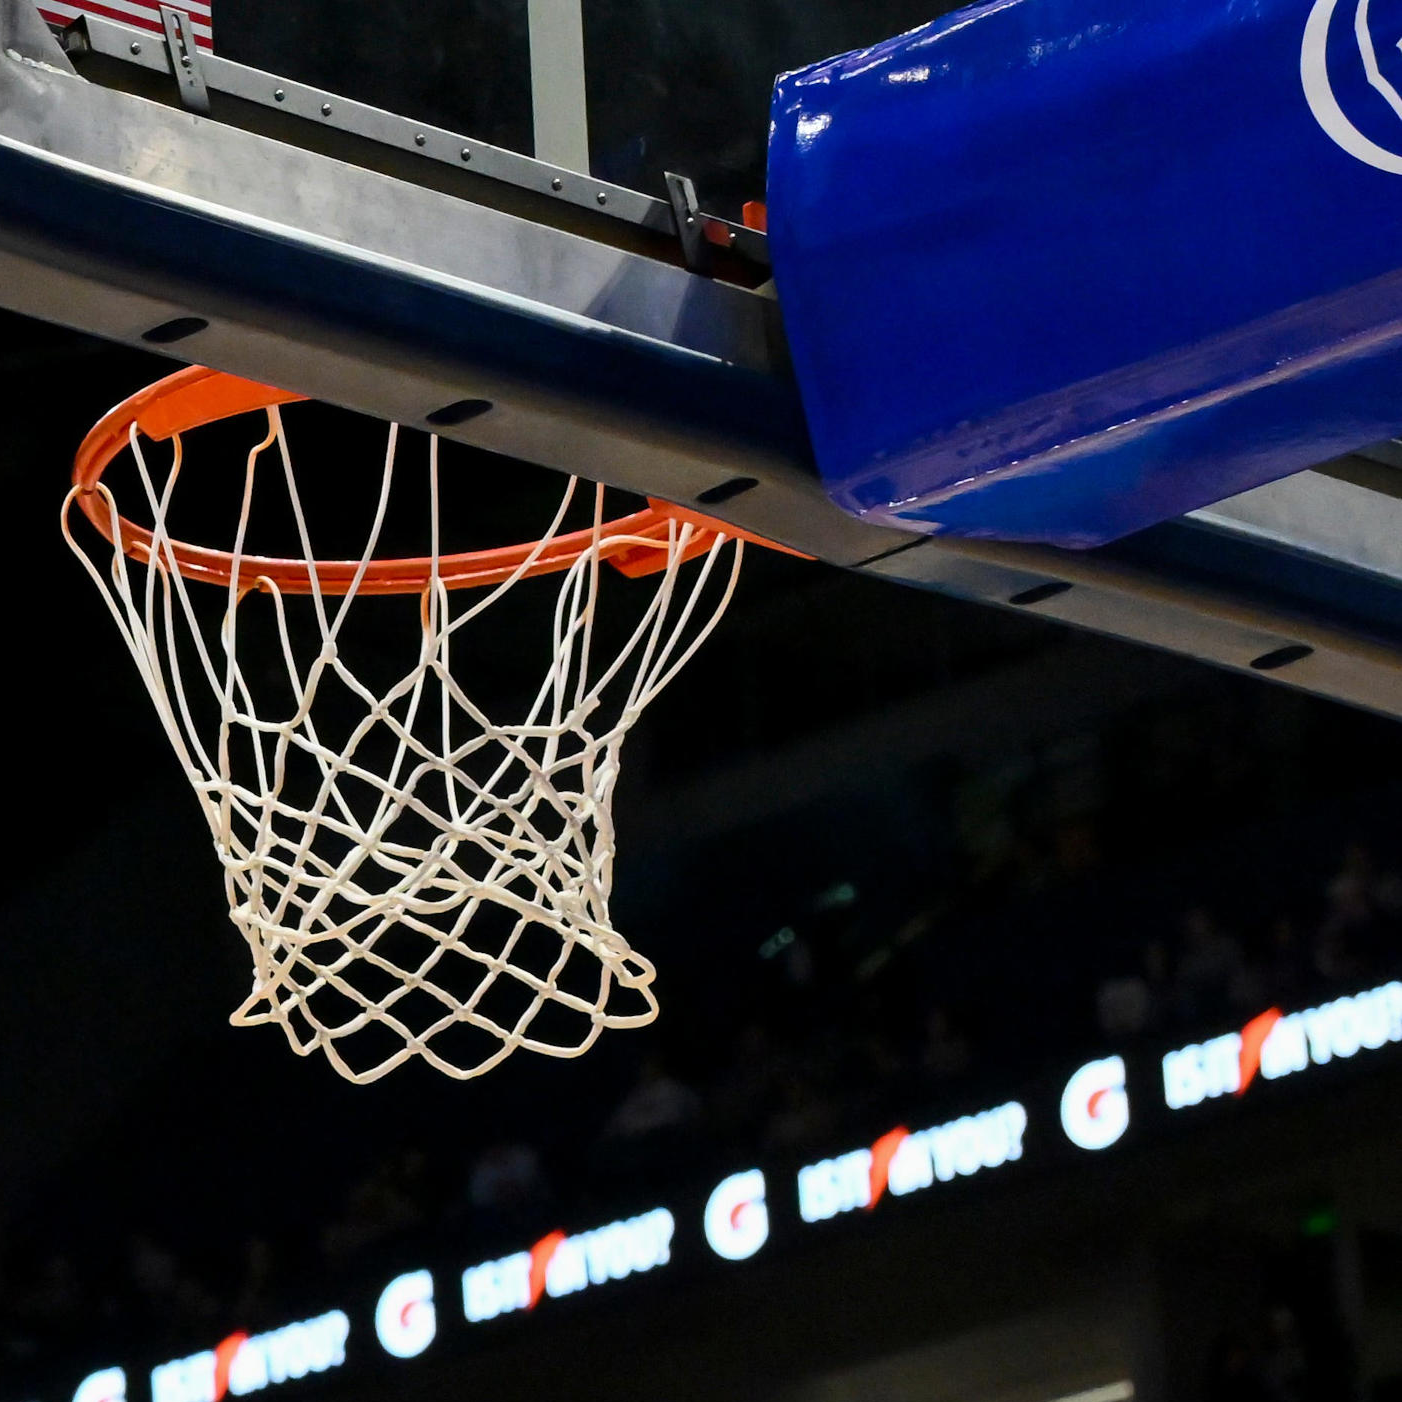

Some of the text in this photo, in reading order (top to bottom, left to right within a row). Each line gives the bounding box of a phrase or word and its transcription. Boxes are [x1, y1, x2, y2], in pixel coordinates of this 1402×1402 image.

[375, 1270, 436, 1358] G
[704, 1169, 769, 1260] G
[1060, 1056, 1129, 1150] G
